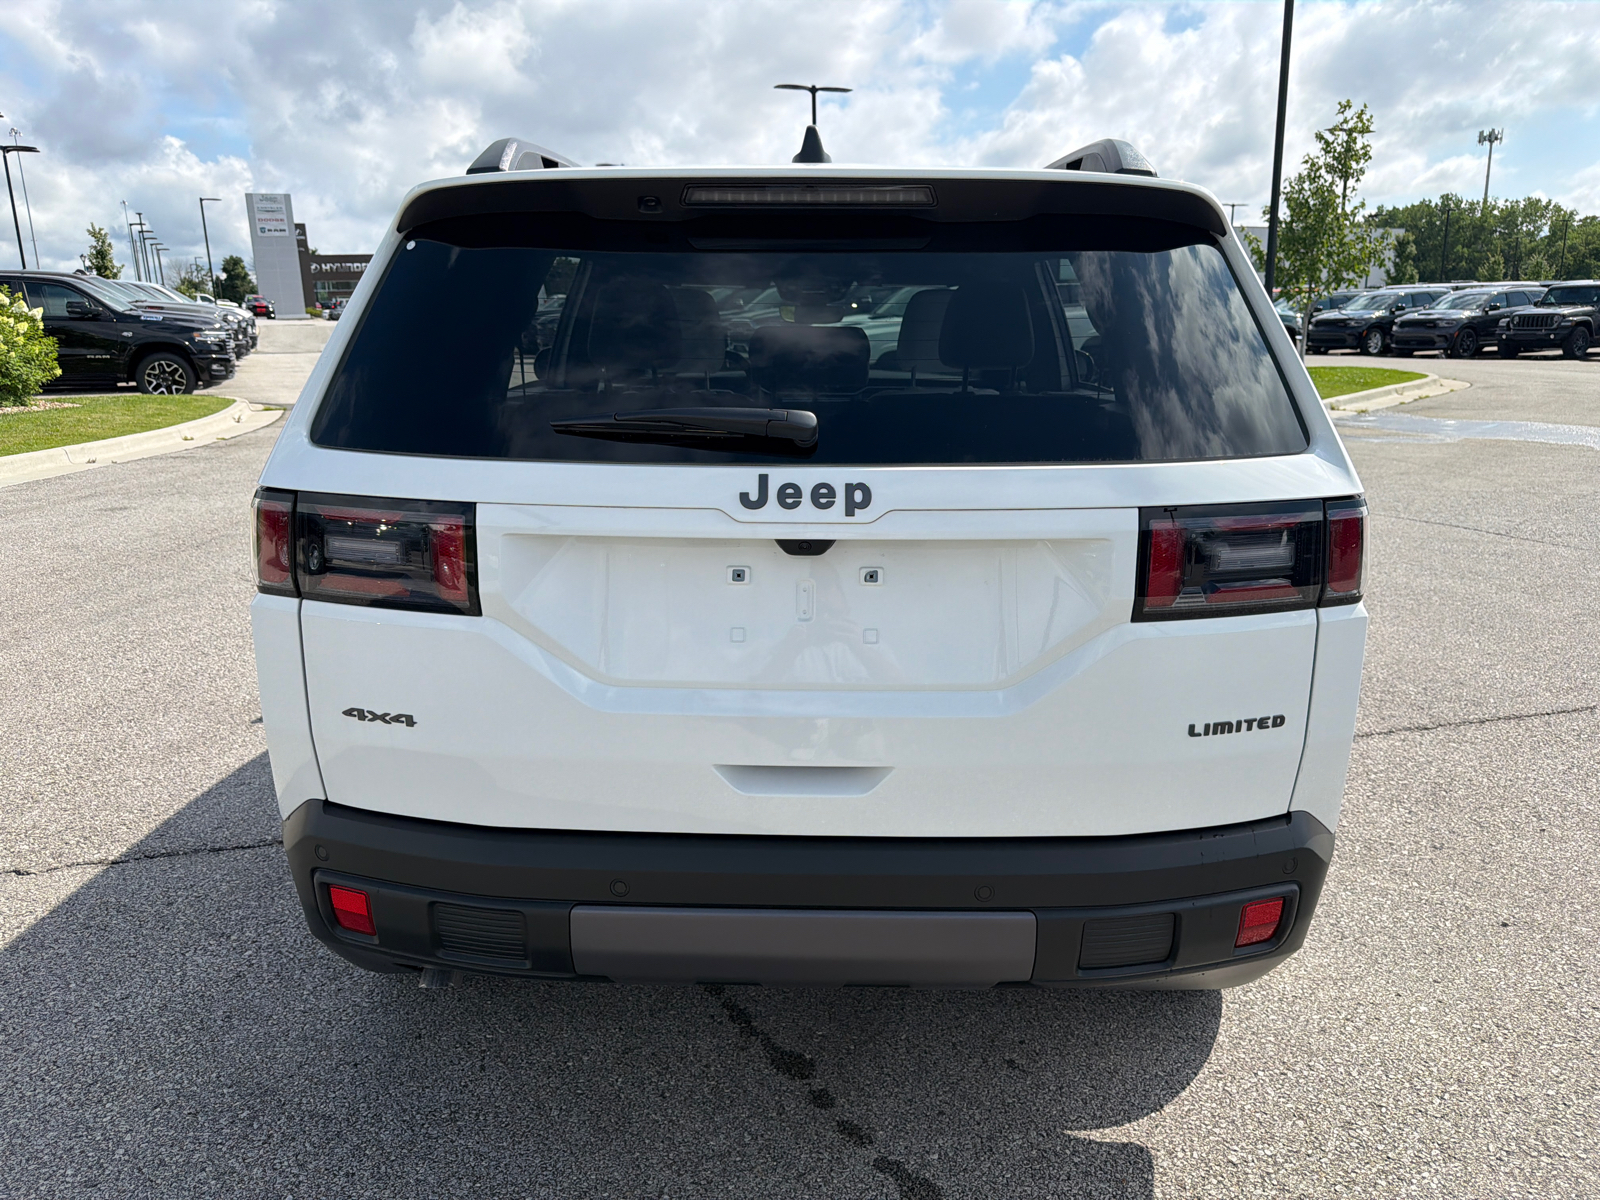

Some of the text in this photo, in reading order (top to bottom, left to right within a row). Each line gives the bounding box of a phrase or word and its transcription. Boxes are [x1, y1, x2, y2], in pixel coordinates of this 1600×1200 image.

[321, 262, 369, 272] HYUNDA
[739, 473, 872, 517] Jeep
[1187, 714, 1286, 738] LIMITED
